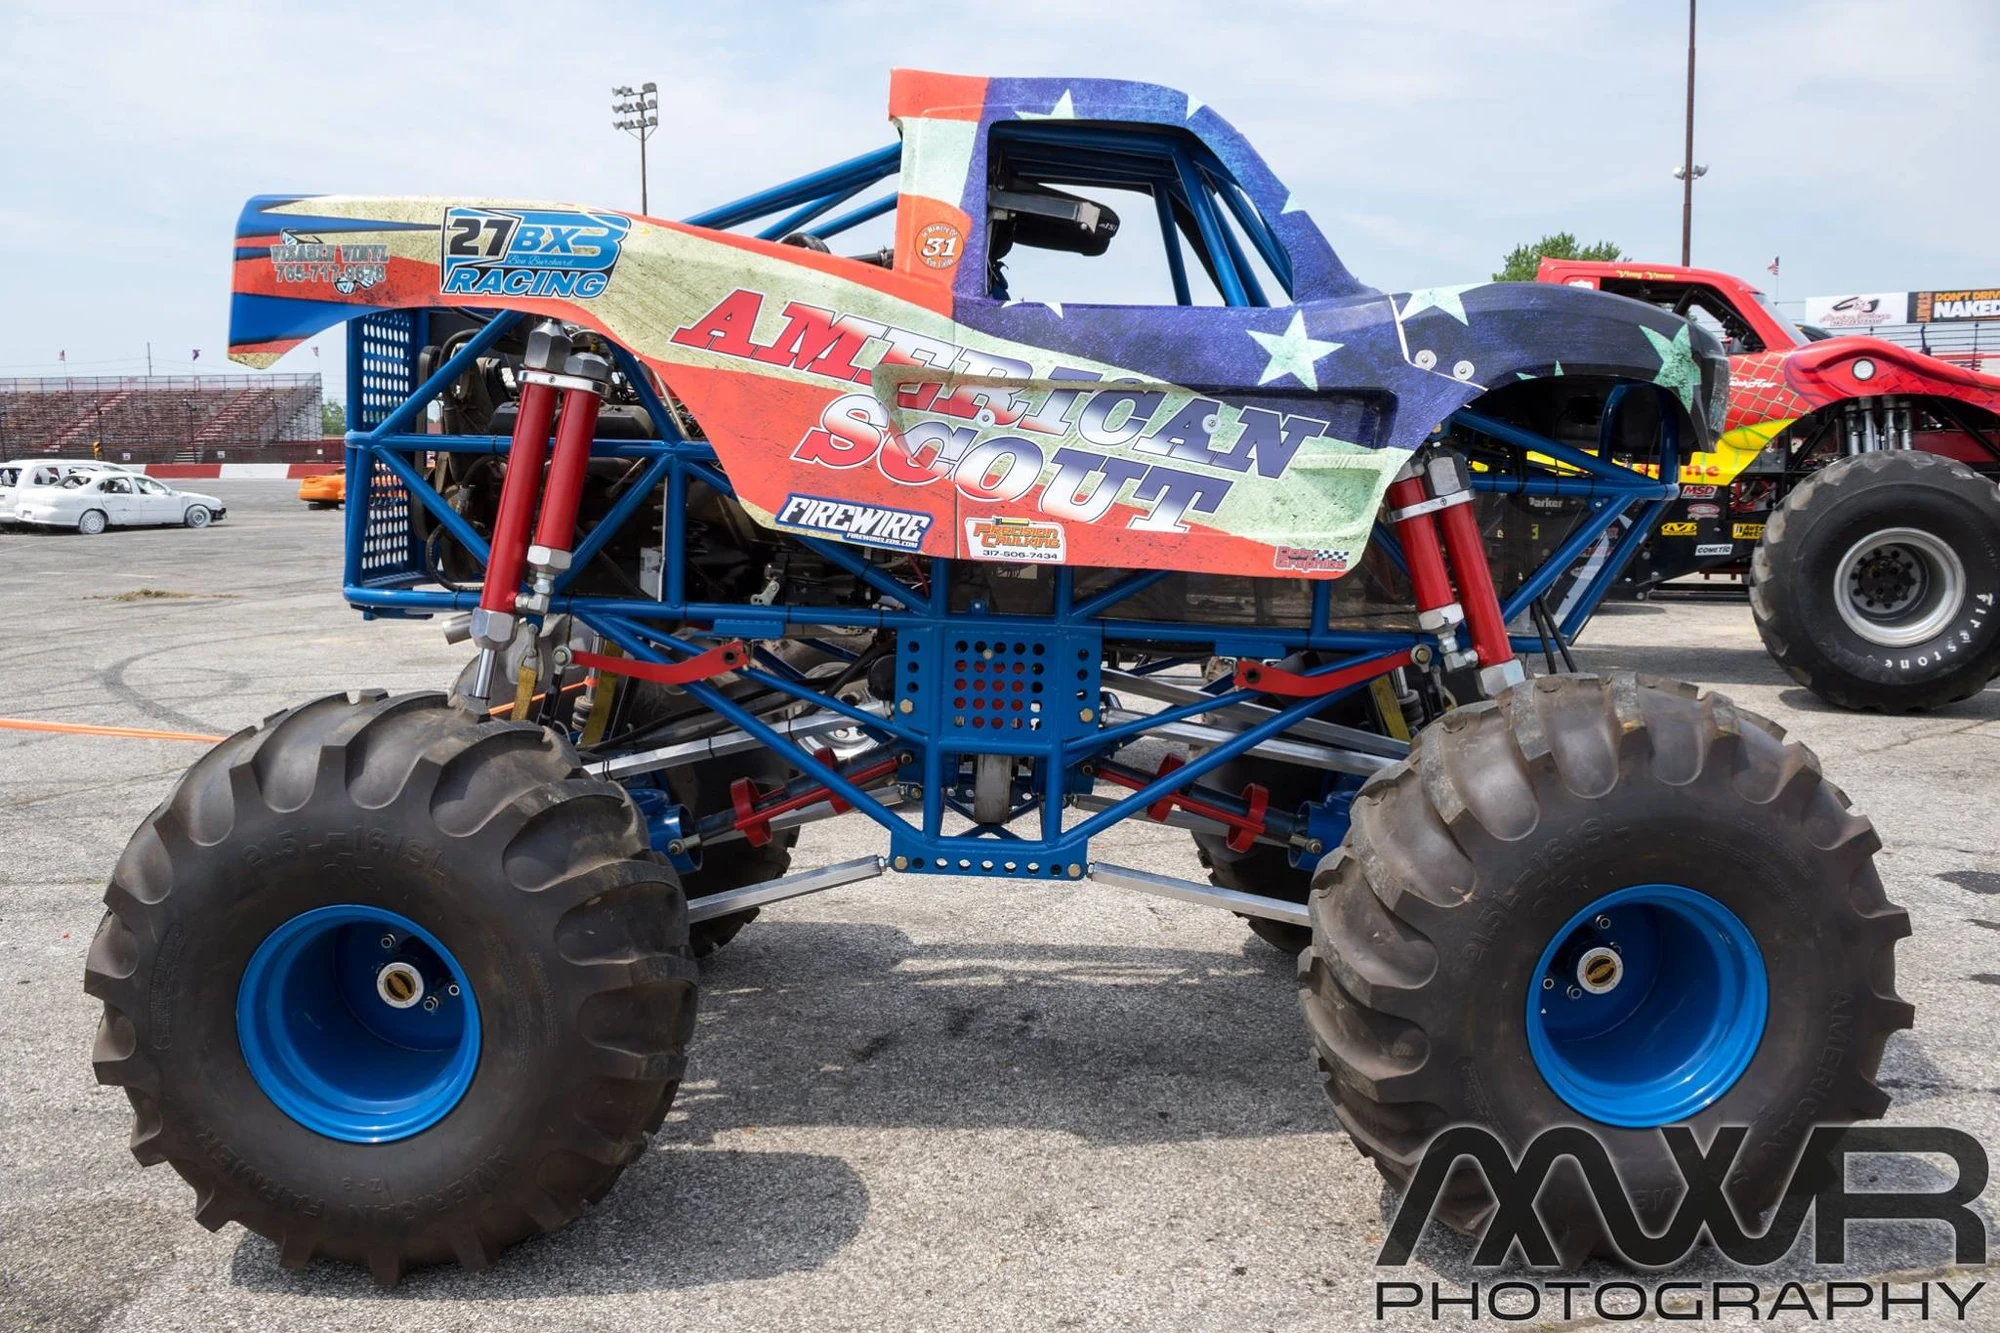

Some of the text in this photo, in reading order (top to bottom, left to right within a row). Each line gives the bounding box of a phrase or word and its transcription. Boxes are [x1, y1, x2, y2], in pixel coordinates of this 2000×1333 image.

[449, 218, 514, 257] 27
[922, 236, 957, 257] 31
[446, 267, 609, 298] RACING
[1934, 292, 1971, 302] DON'T
[1933, 299, 2000, 319] NAKED
[669, 288, 1331, 480] AMERICAN
[789, 393, 1235, 534] SCOUT
[1684, 485, 1715, 496] MSD
[779, 496, 931, 542] FIREWIRE
[982, 550, 1058, 560] 317-506-7434
[1696, 546, 1731, 555] COMETIC
